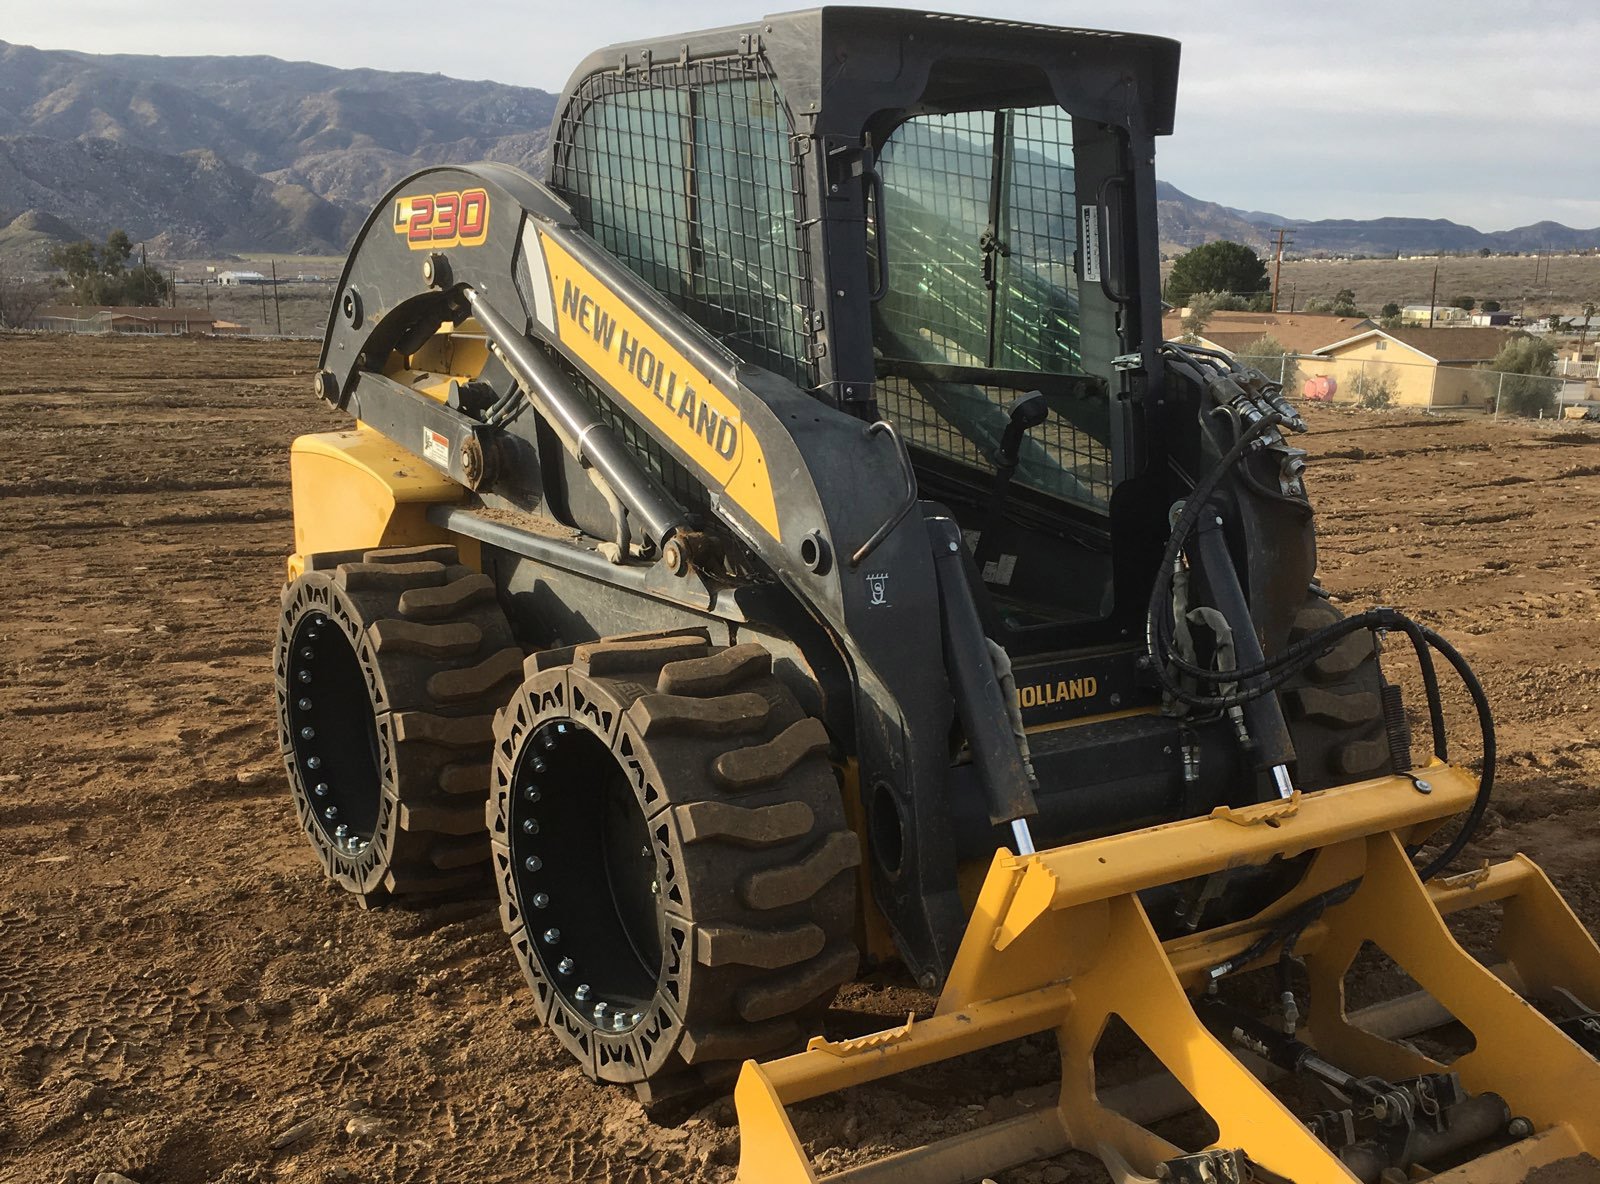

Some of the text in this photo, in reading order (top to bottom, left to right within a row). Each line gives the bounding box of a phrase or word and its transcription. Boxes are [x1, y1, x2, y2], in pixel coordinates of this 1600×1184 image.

[395, 191, 488, 243] L230
[561, 277, 738, 462] NEW HOLLAND
